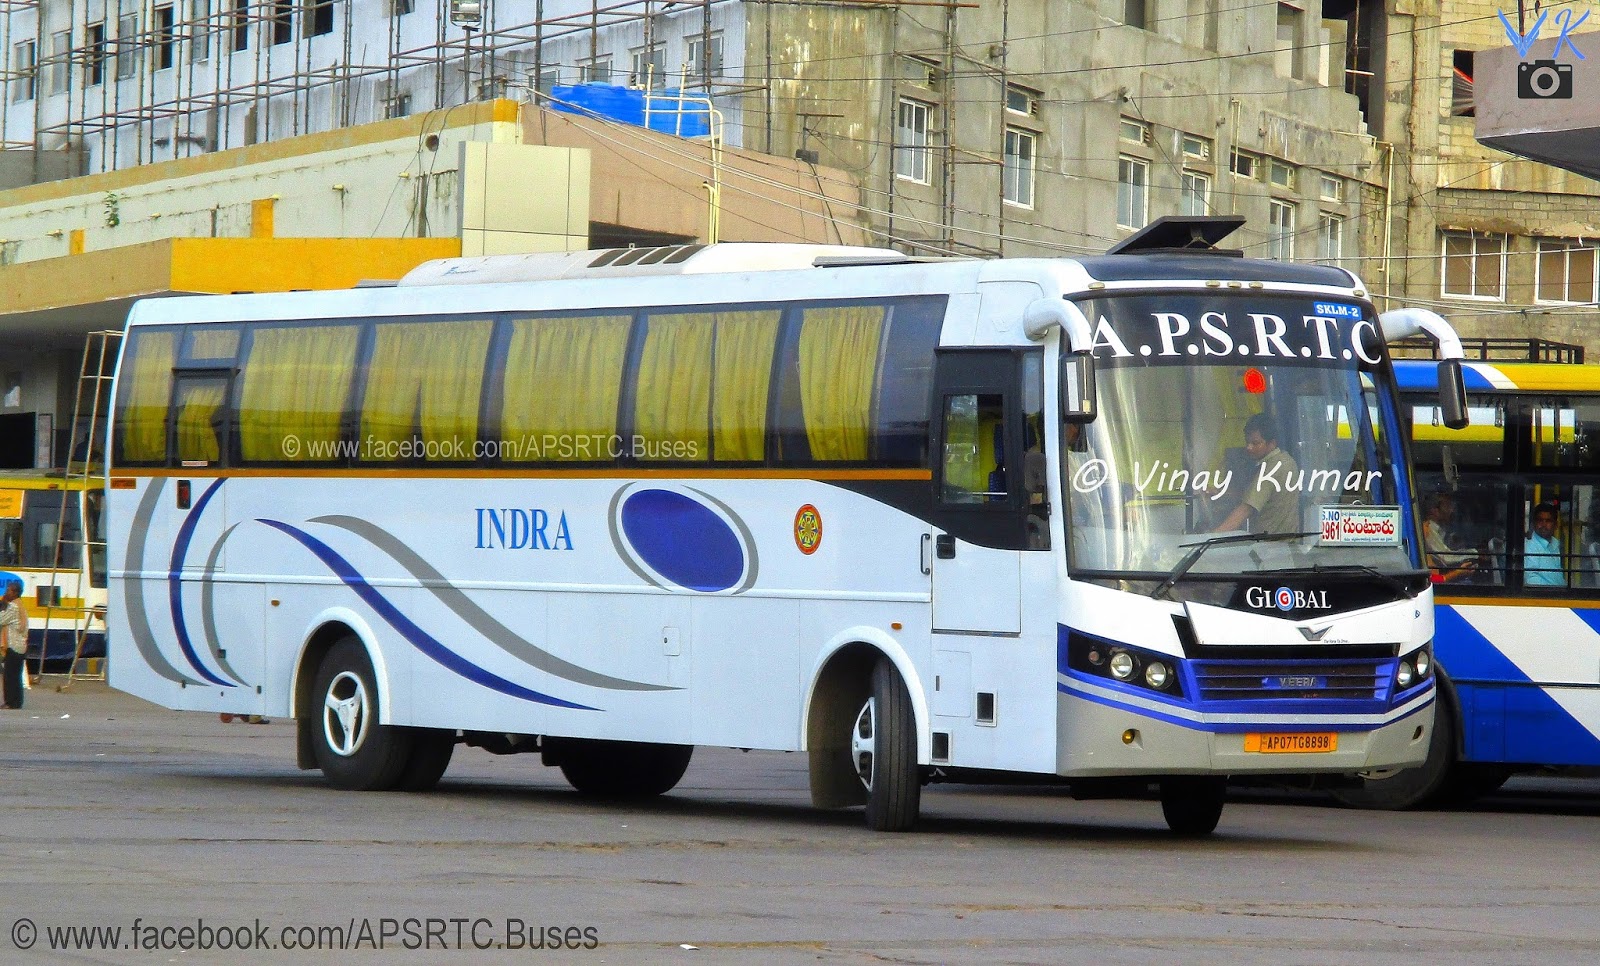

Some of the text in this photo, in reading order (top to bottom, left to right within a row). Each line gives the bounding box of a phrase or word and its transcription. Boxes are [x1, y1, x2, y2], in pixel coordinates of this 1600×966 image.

[1316, 304, 1360, 317] SKLM-2
[1091, 311, 1382, 365] A.P.S.R.T.C
[474, 508, 574, 551] INDRA
[1246, 586, 1332, 612] GLOBAL
[1267, 736, 1329, 750] AP07TG8898
